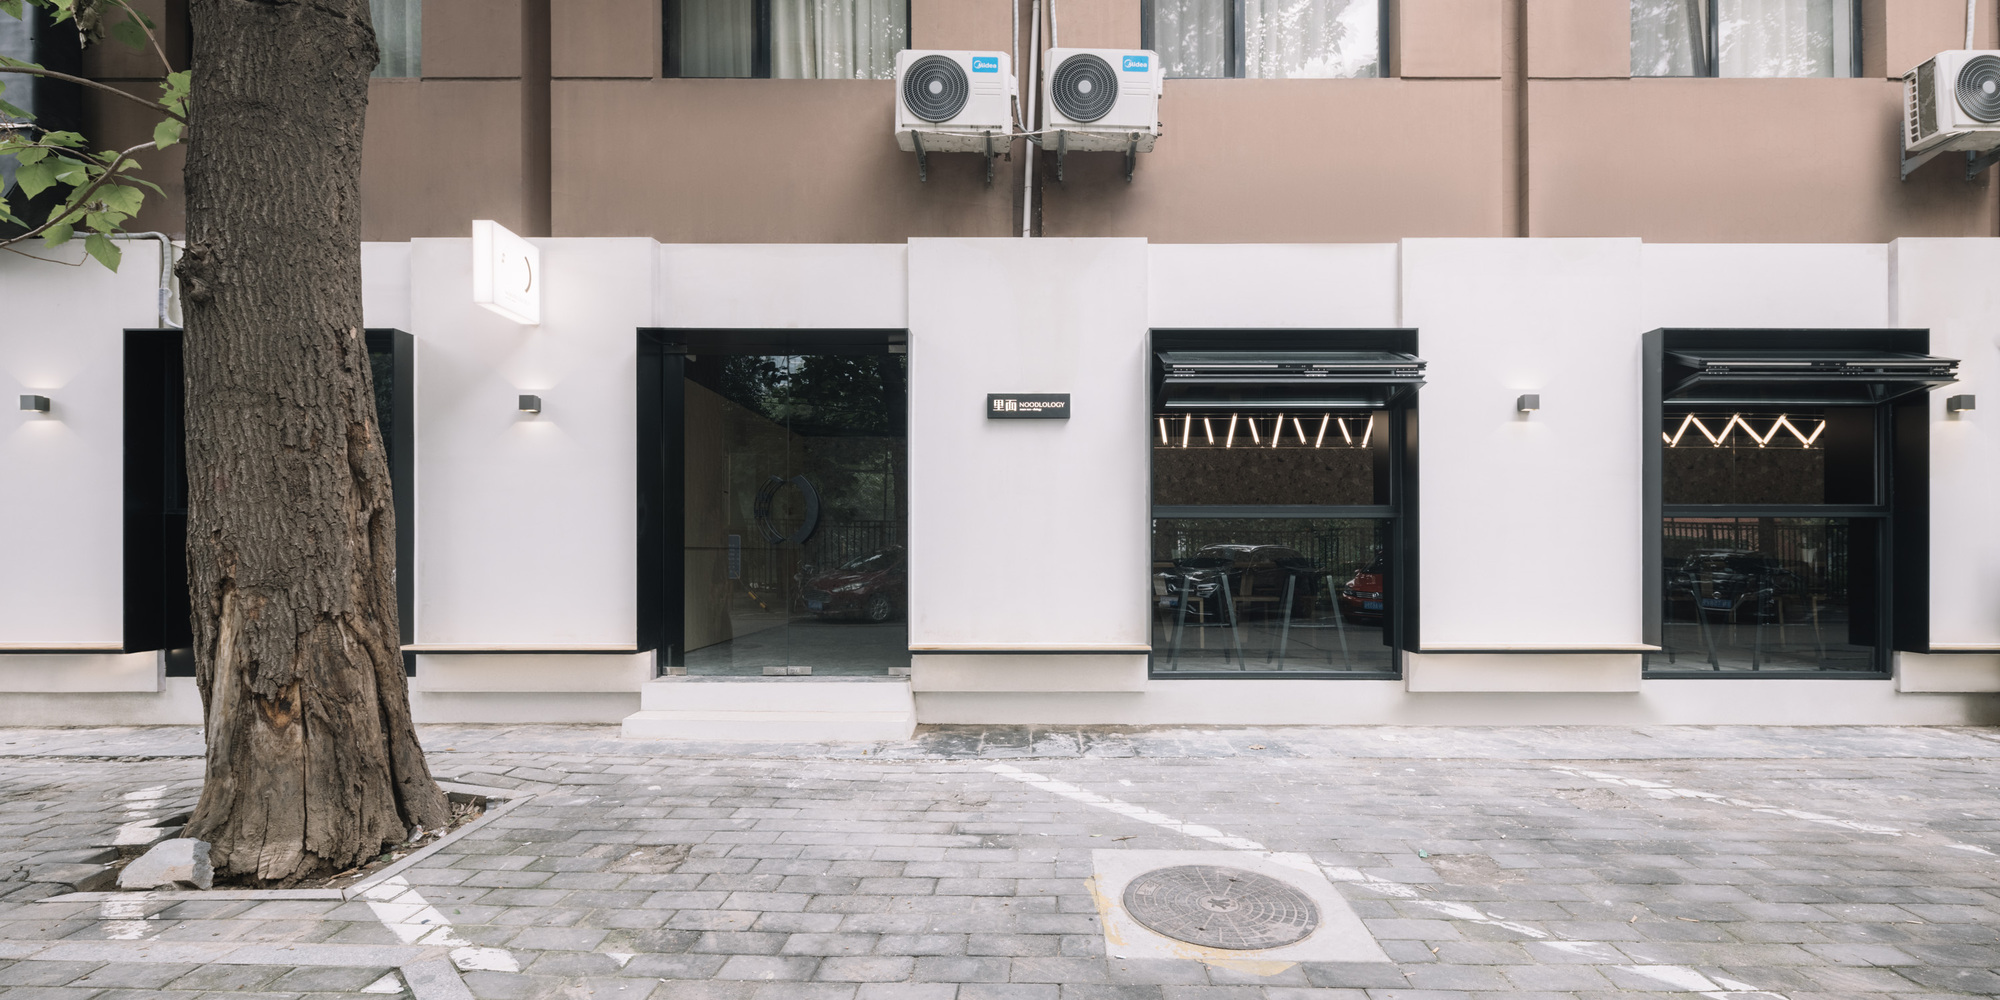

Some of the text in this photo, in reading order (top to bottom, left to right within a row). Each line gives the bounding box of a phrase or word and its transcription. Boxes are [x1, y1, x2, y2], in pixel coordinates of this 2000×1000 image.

[974, 60, 997, 69] Midea
[1124, 59, 1148, 68] Midea
[993, 399, 1017, 412] 里面
